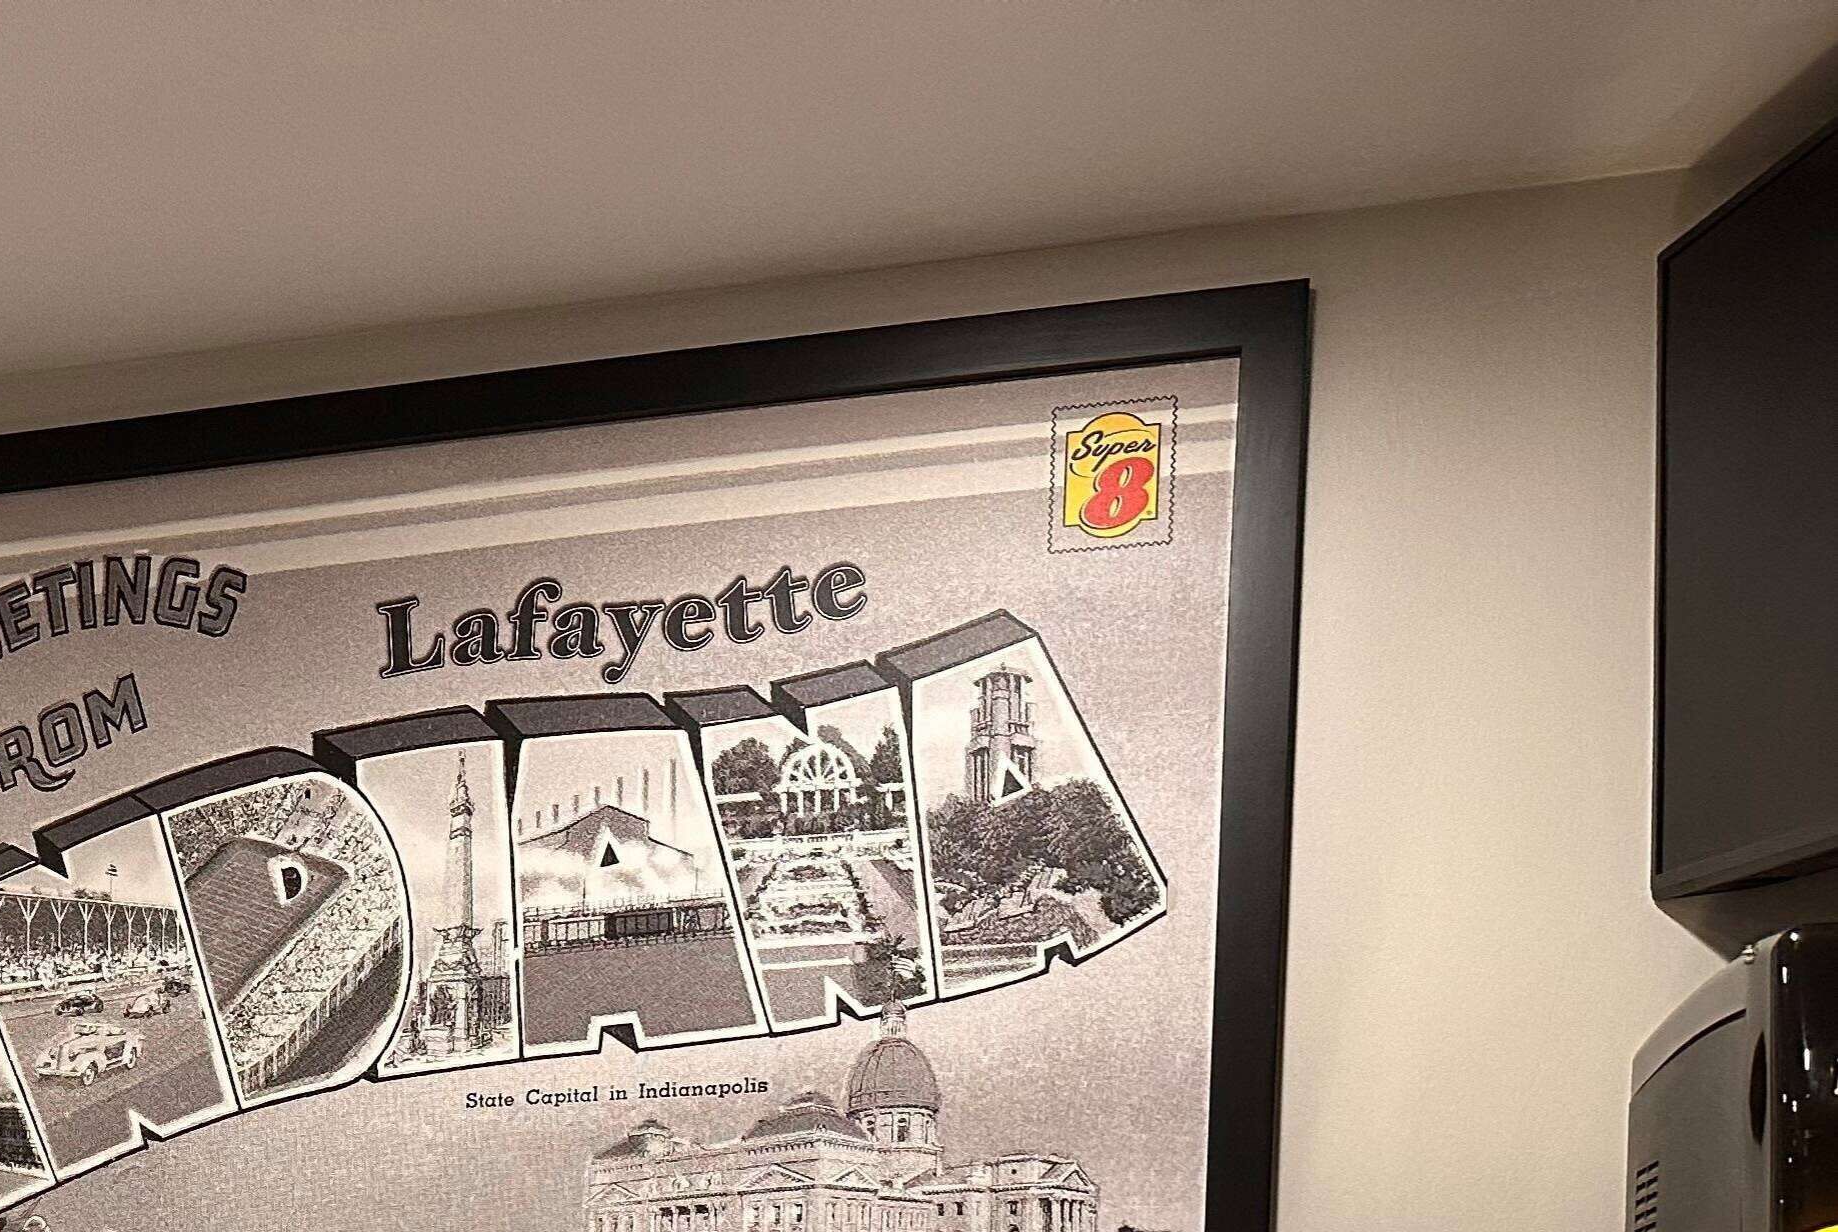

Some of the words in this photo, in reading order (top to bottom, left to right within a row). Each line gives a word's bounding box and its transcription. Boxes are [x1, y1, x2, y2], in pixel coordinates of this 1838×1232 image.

[1071, 430, 1156, 473] Super
[1079, 456, 1155, 530] 8
[377, 561, 867, 684] Lafayette
[465, 1092, 514, 1109] State
[525, 1086, 598, 1107] Capital
[608, 1085, 628, 1101] in
[638, 1077, 768, 1100] Indianapolis
